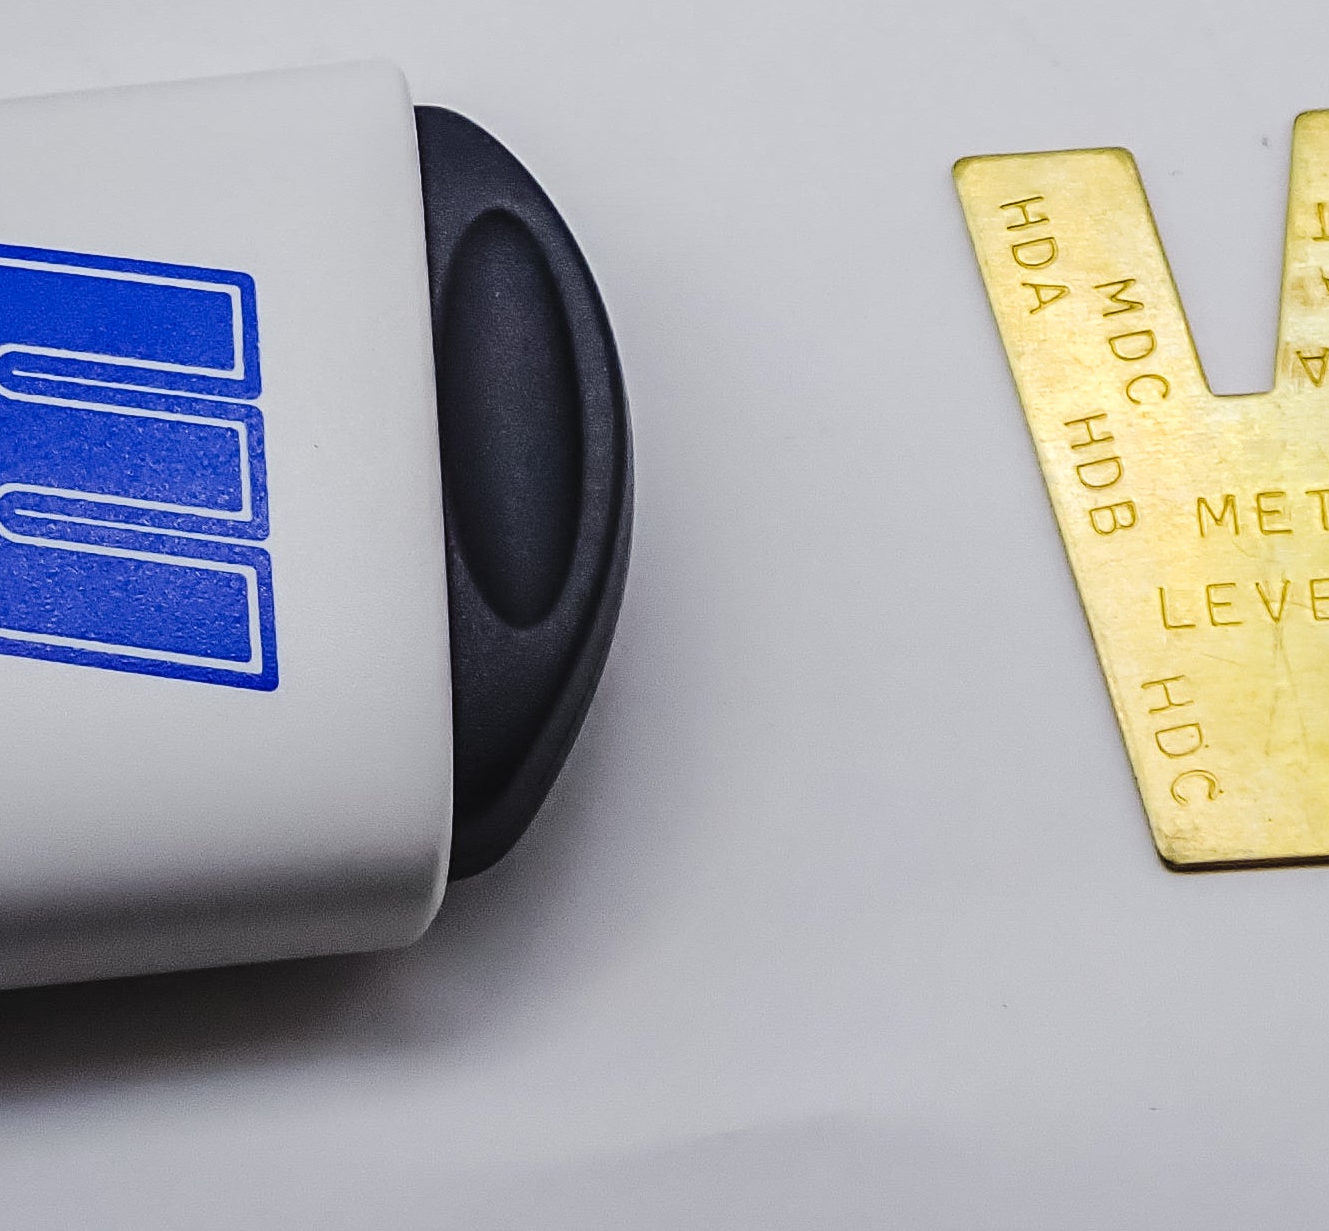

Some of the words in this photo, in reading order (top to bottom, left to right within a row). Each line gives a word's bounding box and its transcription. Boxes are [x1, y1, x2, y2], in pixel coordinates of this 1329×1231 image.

[999, 195, 1070, 315] HDA
[1063, 412, 1139, 537] HDB
[1140, 674, 1224, 806] HDC
[1092, 277, 1171, 405] MDC
